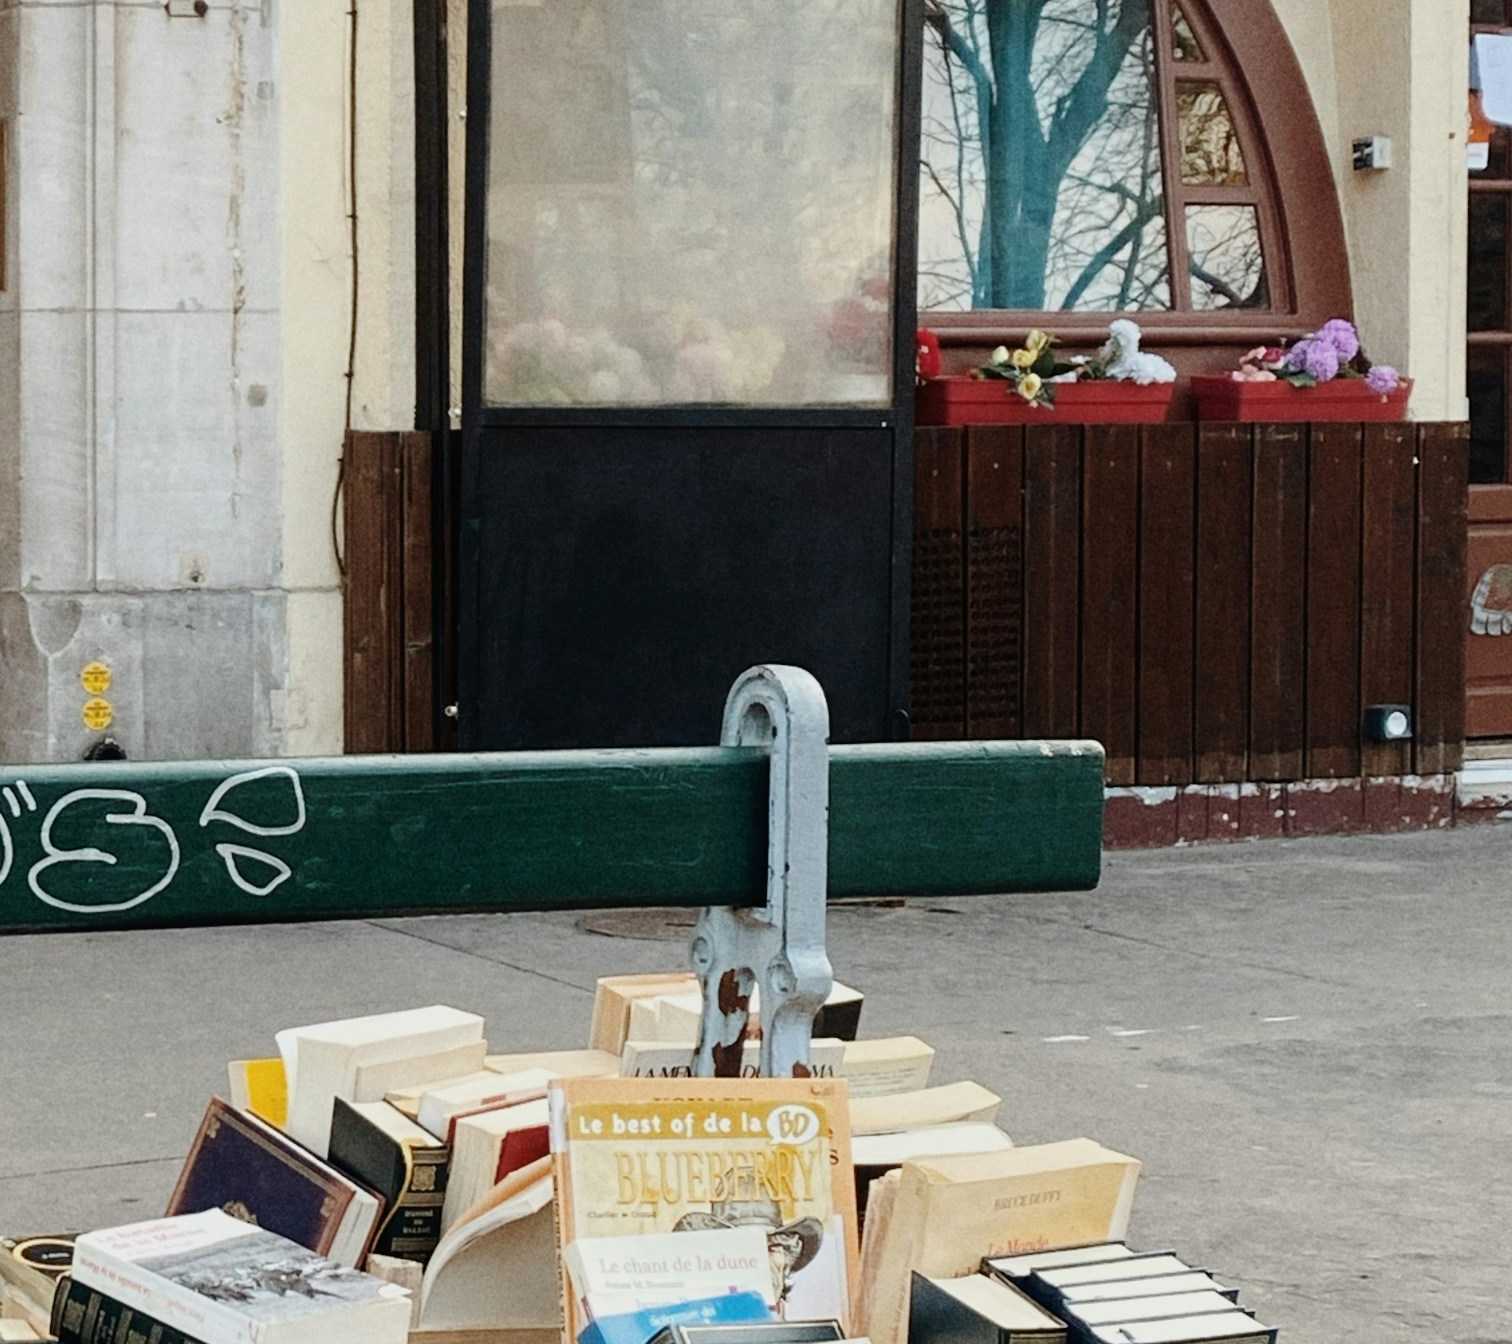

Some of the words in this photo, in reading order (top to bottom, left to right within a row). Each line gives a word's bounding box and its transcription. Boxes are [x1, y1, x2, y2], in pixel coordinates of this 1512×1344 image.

[579, 1115, 603, 1134] Le
[612, 1113, 662, 1134] best
[670, 1112, 694, 1138] of
[703, 1112, 732, 1134] de
[740, 1112, 762, 1133] la
[777, 1109, 811, 1139] BD
[613, 1148, 820, 1205] BLUEBERRY
[600, 1258, 620, 1274] Le
[623, 1256, 671, 1274] chant
[674, 1255, 694, 1272] de
[697, 1255, 715, 1272] la
[717, 1254, 758, 1271] dune
